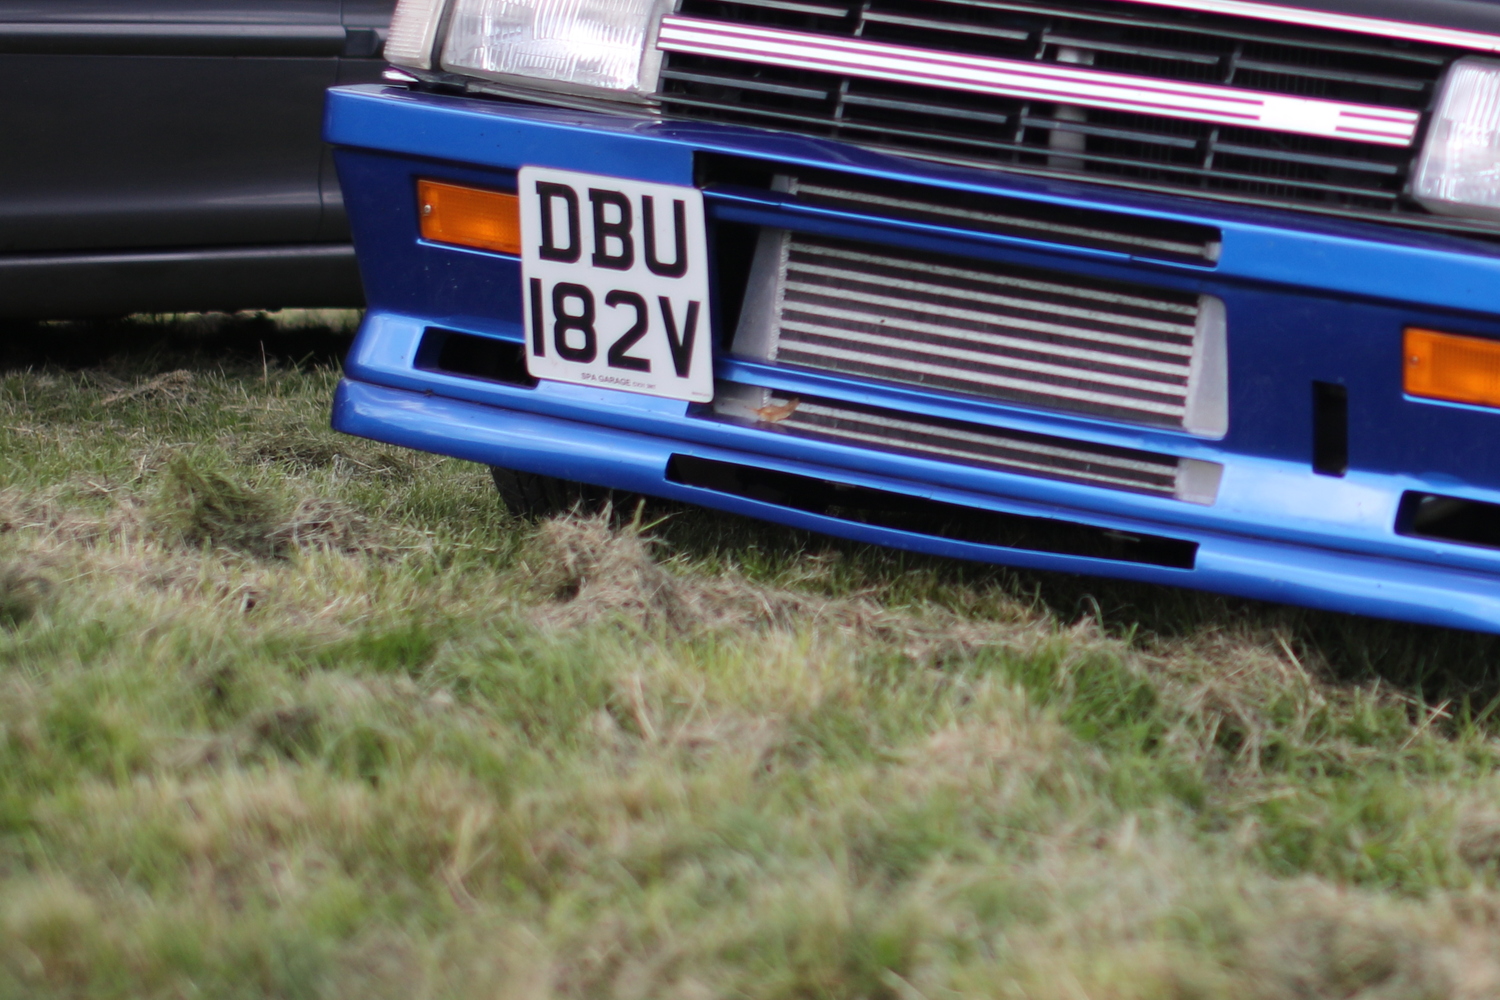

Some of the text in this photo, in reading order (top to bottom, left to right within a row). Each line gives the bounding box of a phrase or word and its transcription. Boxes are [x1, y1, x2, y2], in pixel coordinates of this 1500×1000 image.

[535, 180, 689, 280] DBU
[529, 277, 701, 379] 182V
[581, 372, 597, 381] SPA
[598, 375, 631, 387] GARAGE
